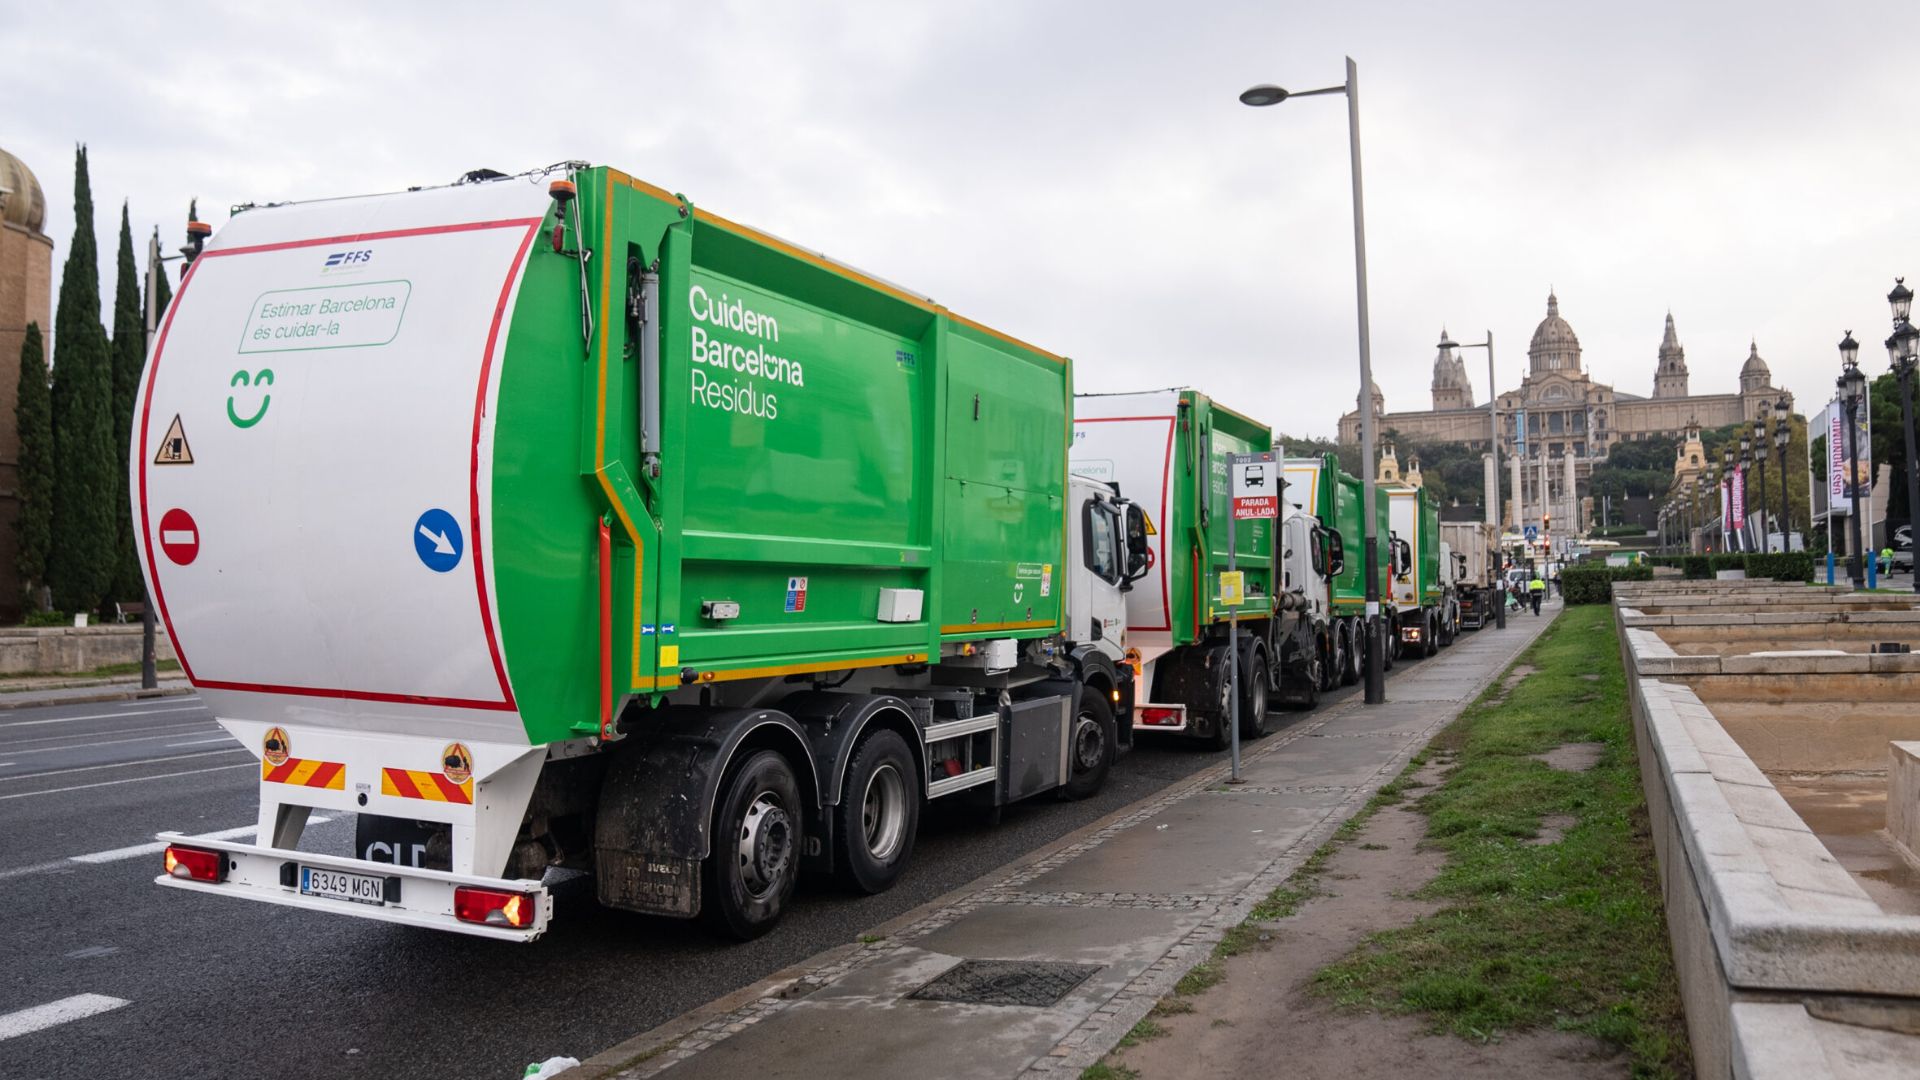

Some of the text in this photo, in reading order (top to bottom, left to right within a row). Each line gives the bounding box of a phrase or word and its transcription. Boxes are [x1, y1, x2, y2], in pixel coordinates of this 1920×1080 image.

[344, 249, 373, 264] FFS
[260, 296, 396, 319] Estimar Barcelona
[689, 285, 779, 342] Cuidem
[253, 320, 340, 340] és cuidar-la
[691, 326, 804, 387] Barcelona
[691, 368, 777, 420] Residus
[1241, 498, 1270, 506] PARADA
[312, 872, 347, 893] 6349
[352, 878, 381, 898] MGN
